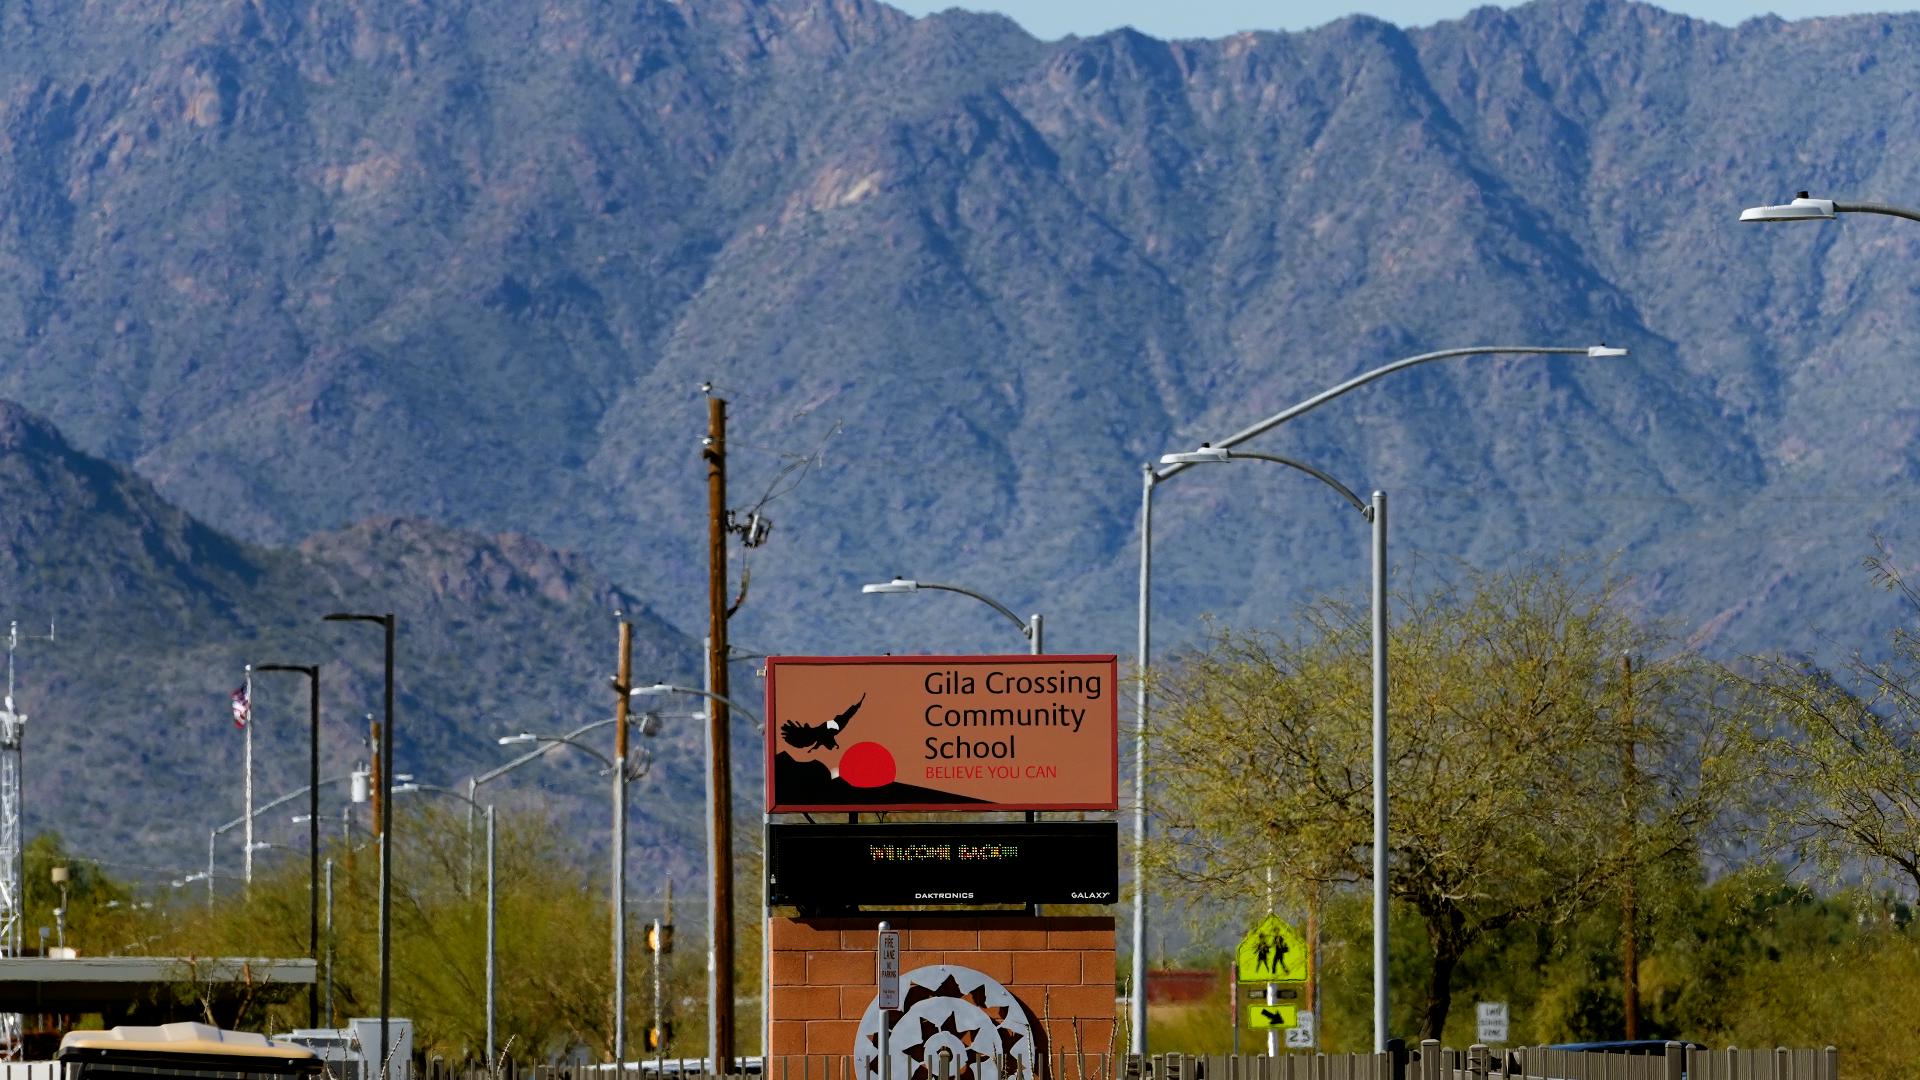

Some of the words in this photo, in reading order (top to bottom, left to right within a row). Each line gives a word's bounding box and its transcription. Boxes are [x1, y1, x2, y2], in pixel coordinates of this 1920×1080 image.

[924, 670, 975, 695] Gila
[985, 670, 1101, 700] Crossing
[924, 702, 1086, 733] Community
[924, 735, 1015, 760] School
[925, 766, 983, 779] BELIEVE
[987, 766, 1020, 779] YOU
[1025, 765, 1057, 778] CAN
[1071, 891, 1110, 899] GALAXY
[884, 937, 894, 949] FIRE
[883, 949, 896, 960] LANE
[881, 970, 897, 978] PARKING
[1288, 1029, 1310, 1043] 25
